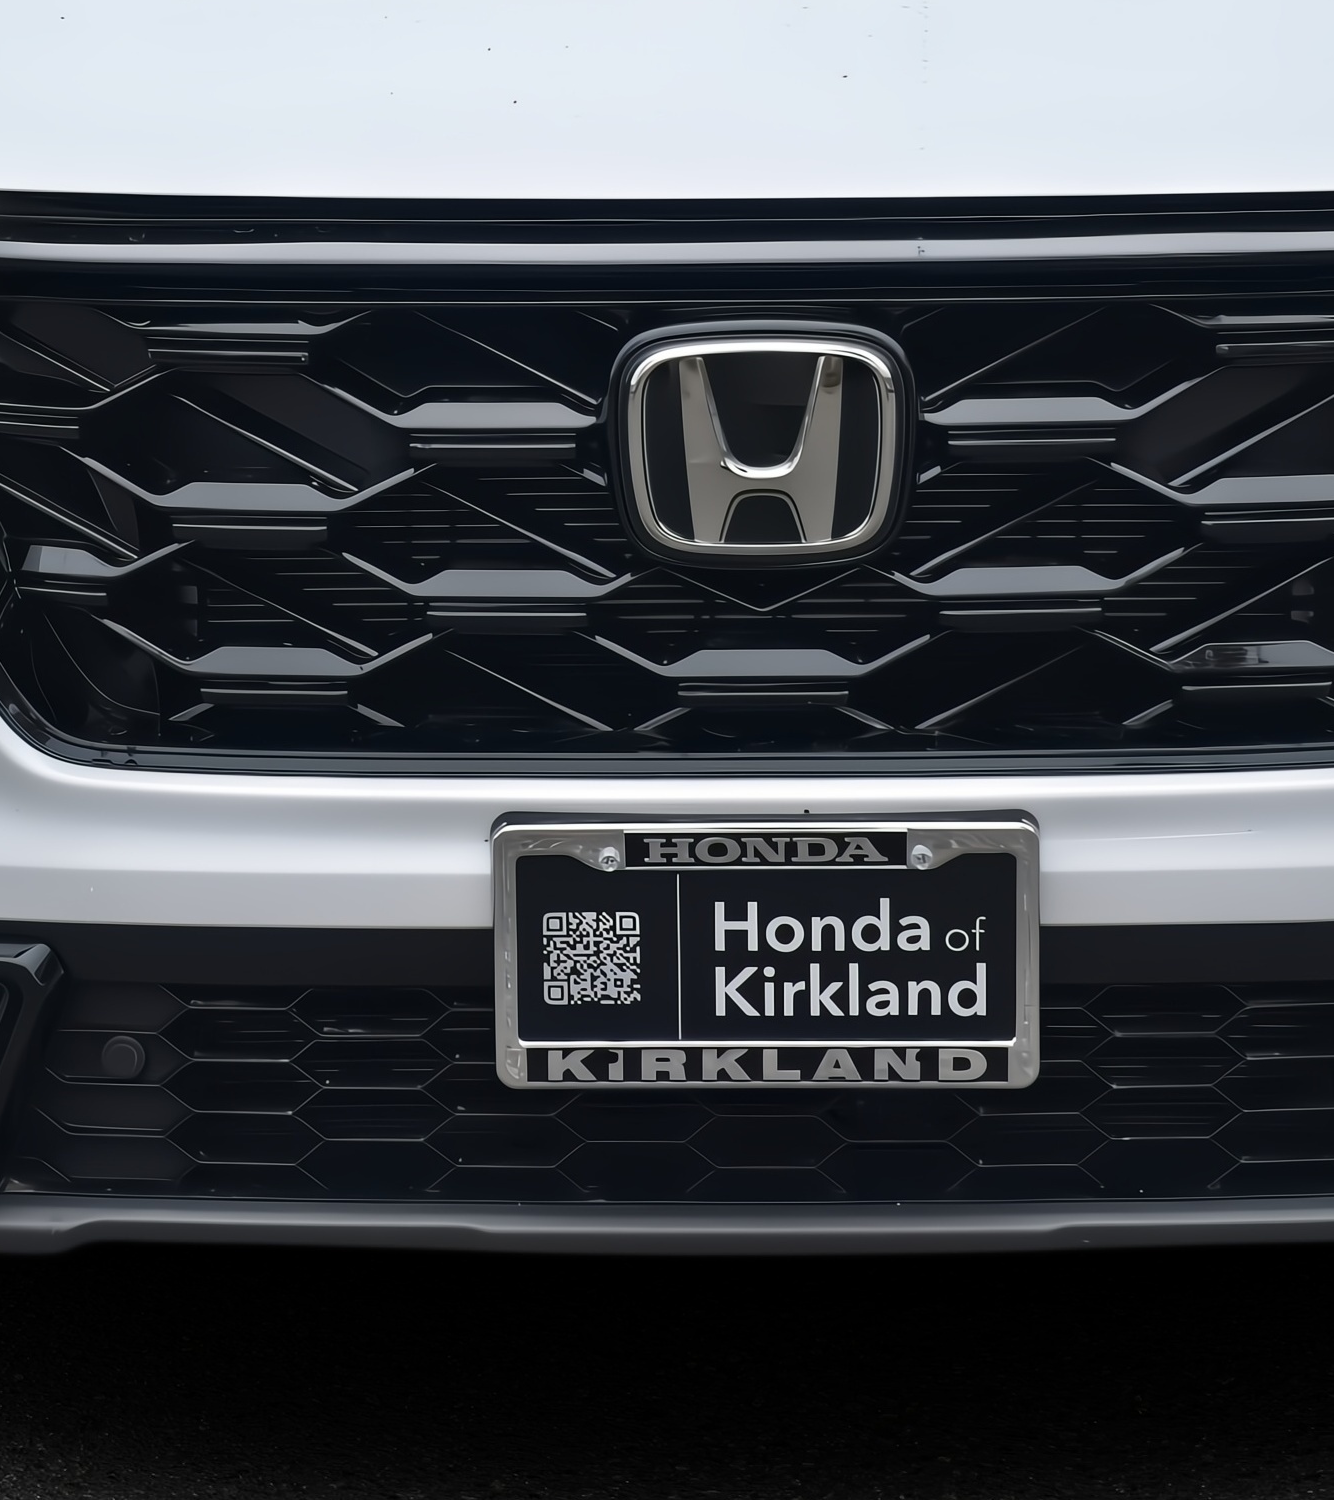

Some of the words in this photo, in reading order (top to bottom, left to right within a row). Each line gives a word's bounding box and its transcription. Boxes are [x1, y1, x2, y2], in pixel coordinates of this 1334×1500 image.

[643, 836, 889, 865] HONDA
[714, 897, 931, 953] Honda
[945, 916, 986, 953] of
[714, 962, 988, 1017] Kirkland
[546, 1048, 988, 1083] KIRKLAND
